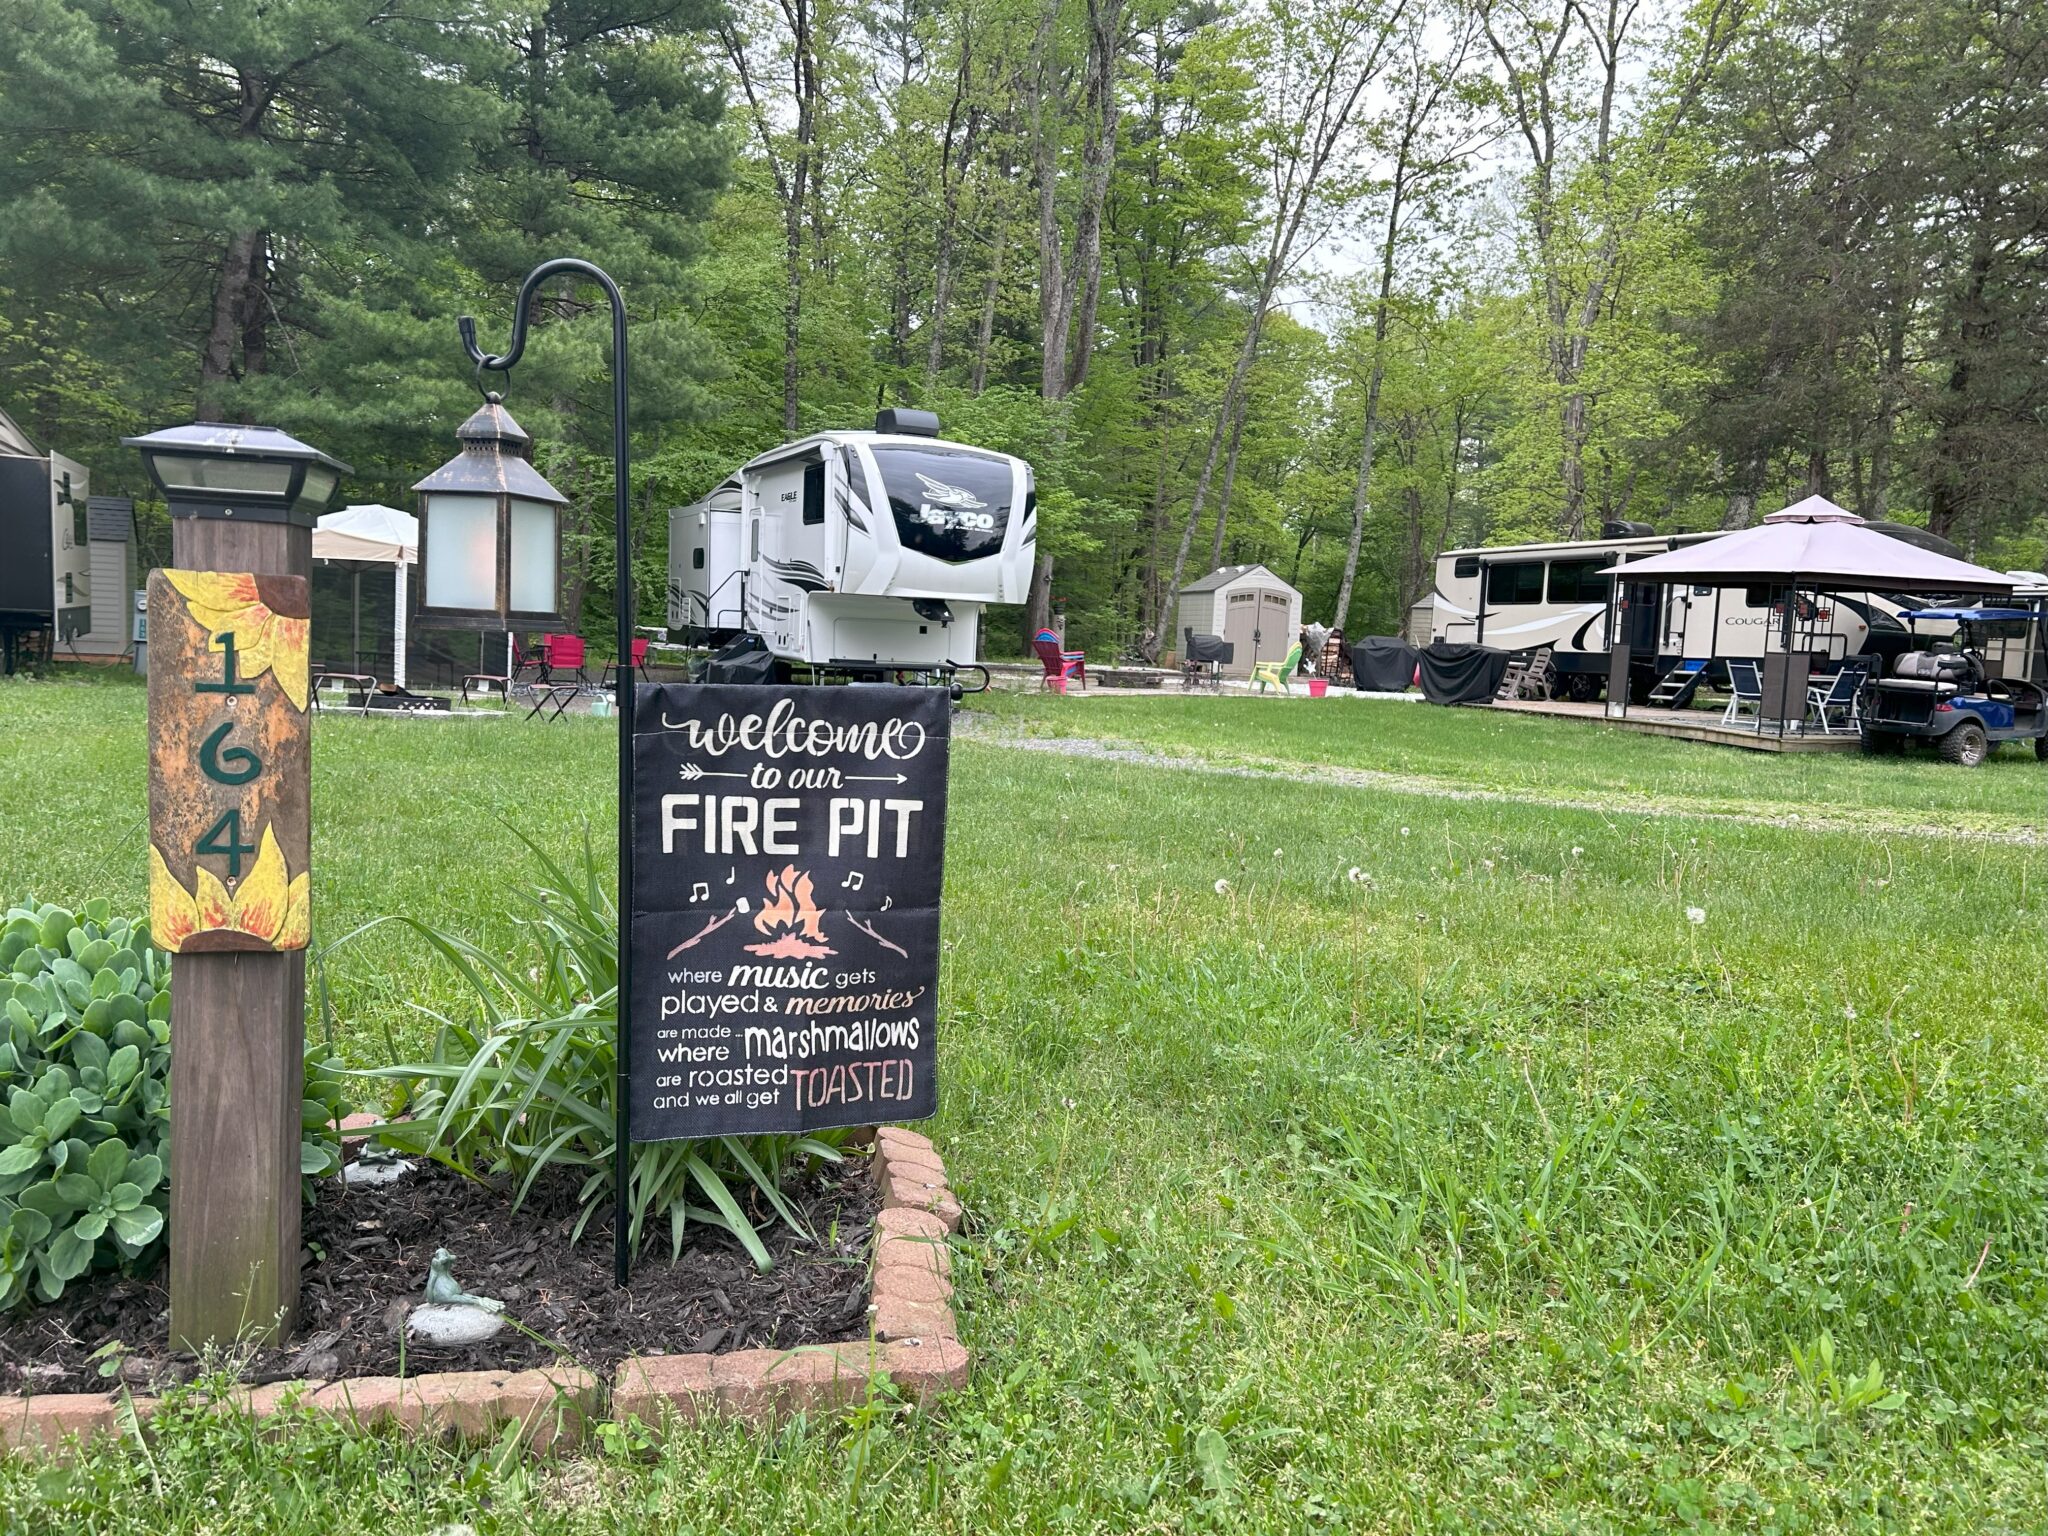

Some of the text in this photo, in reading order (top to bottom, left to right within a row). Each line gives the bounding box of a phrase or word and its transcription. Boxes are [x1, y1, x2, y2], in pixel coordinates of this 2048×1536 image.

[910, 503, 994, 530] Jayco
[662, 698, 925, 760] welcome
[751, 763, 843, 789] to our
[661, 794, 924, 858] FIRE PIT
[668, 961, 876, 989] where music gets
[661, 986, 925, 1020] played & memories
[657, 1028, 678, 1039] are
[681, 1024, 731, 1039] made
[657, 1017, 919, 1063] where marshmallows
[653, 1089, 780, 1109] and we all get
[656, 1059, 914, 1111] are roasted TOASTED
